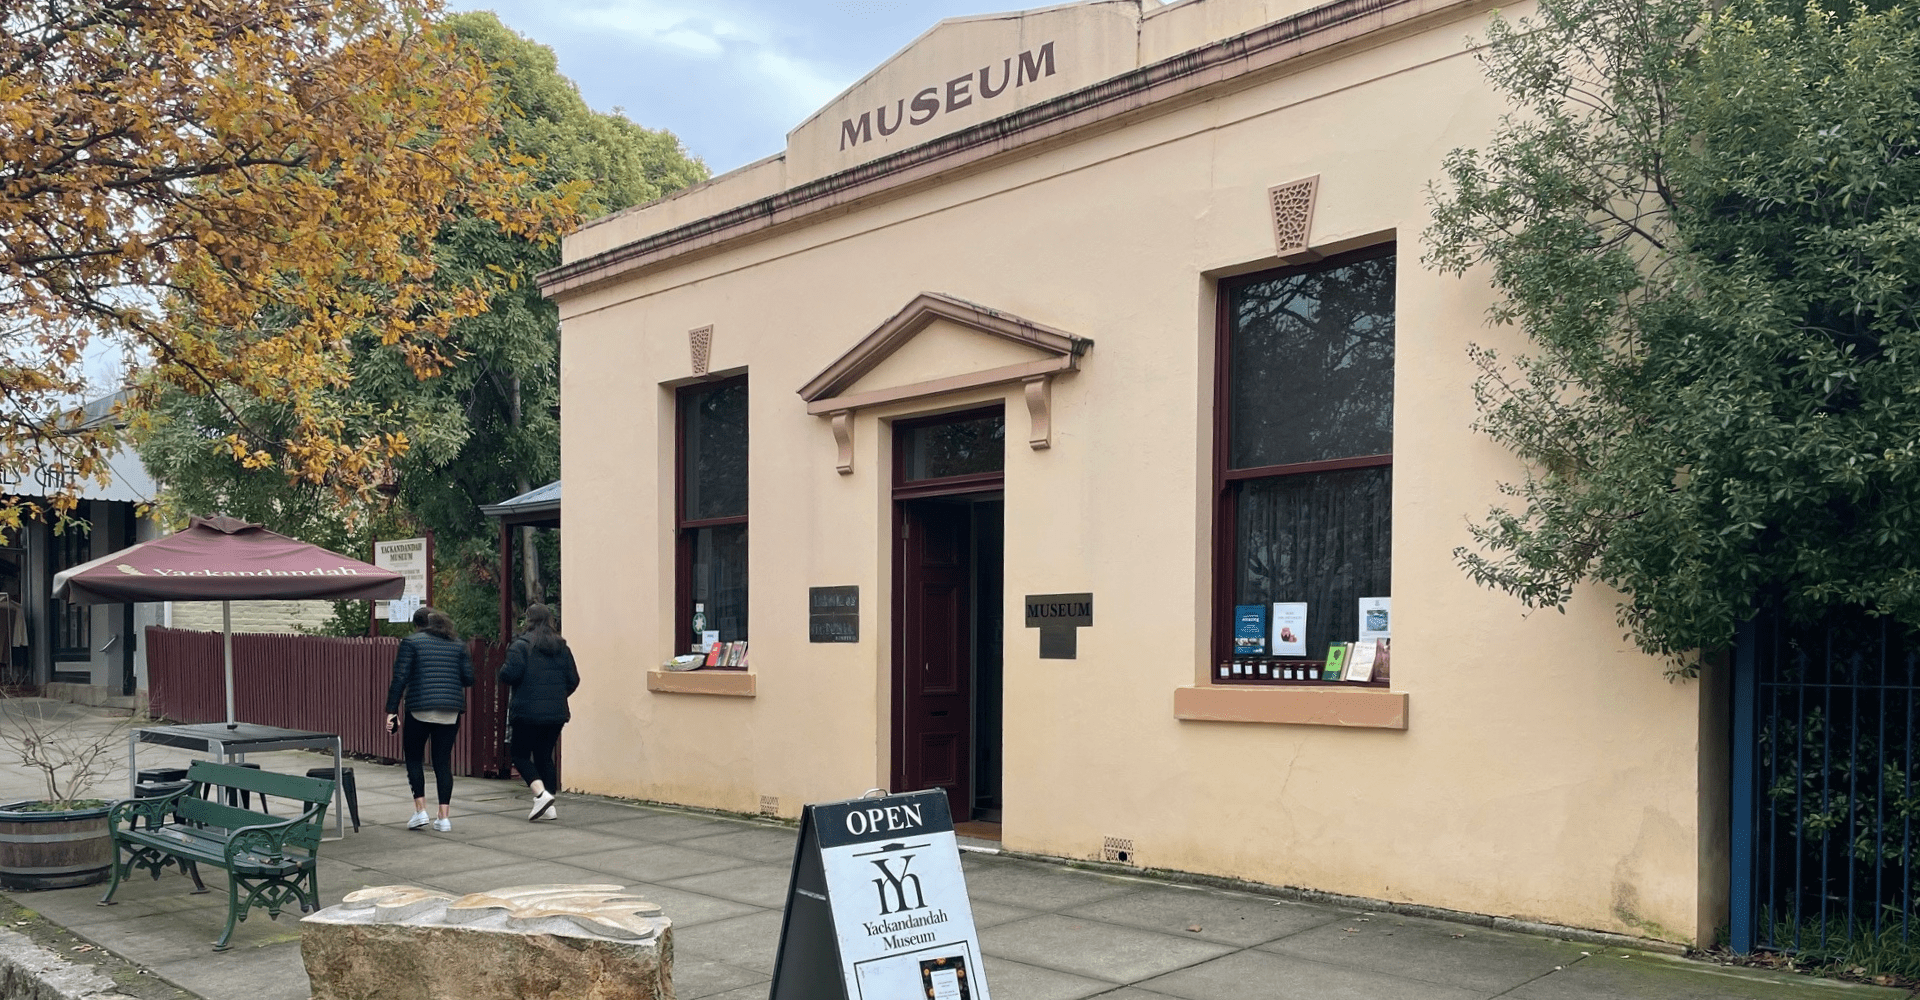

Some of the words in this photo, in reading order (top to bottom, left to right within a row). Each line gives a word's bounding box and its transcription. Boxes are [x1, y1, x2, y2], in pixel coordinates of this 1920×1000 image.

[839, 40, 1056, 152] MUSEUM
[381, 542, 423, 554] YACKANDANDAH
[389, 552, 413, 561] MUSEUM
[152, 566, 358, 577] Yackandandah
[1027, 602, 1091, 618] MUSEUM
[846, 804, 923, 836] OPEN
[862, 908, 948, 937] Yackandandah
[883, 930, 936, 951] Museum
